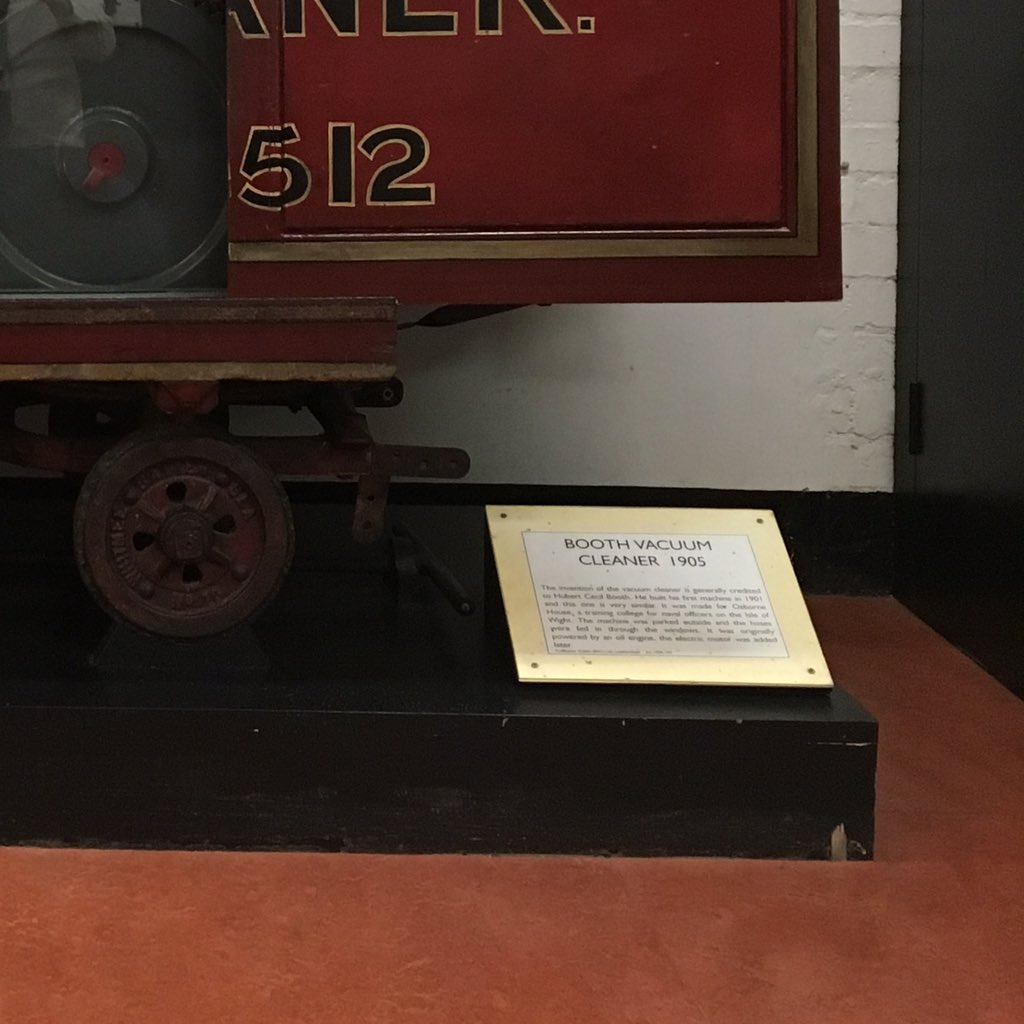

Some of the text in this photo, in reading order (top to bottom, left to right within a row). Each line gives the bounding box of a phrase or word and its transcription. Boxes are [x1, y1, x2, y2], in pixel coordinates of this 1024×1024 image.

[237, 122, 436, 211] 512
[564, 538, 713, 551] BOOTH VACUUM
[578, 555, 707, 567] CLEANER 1905
